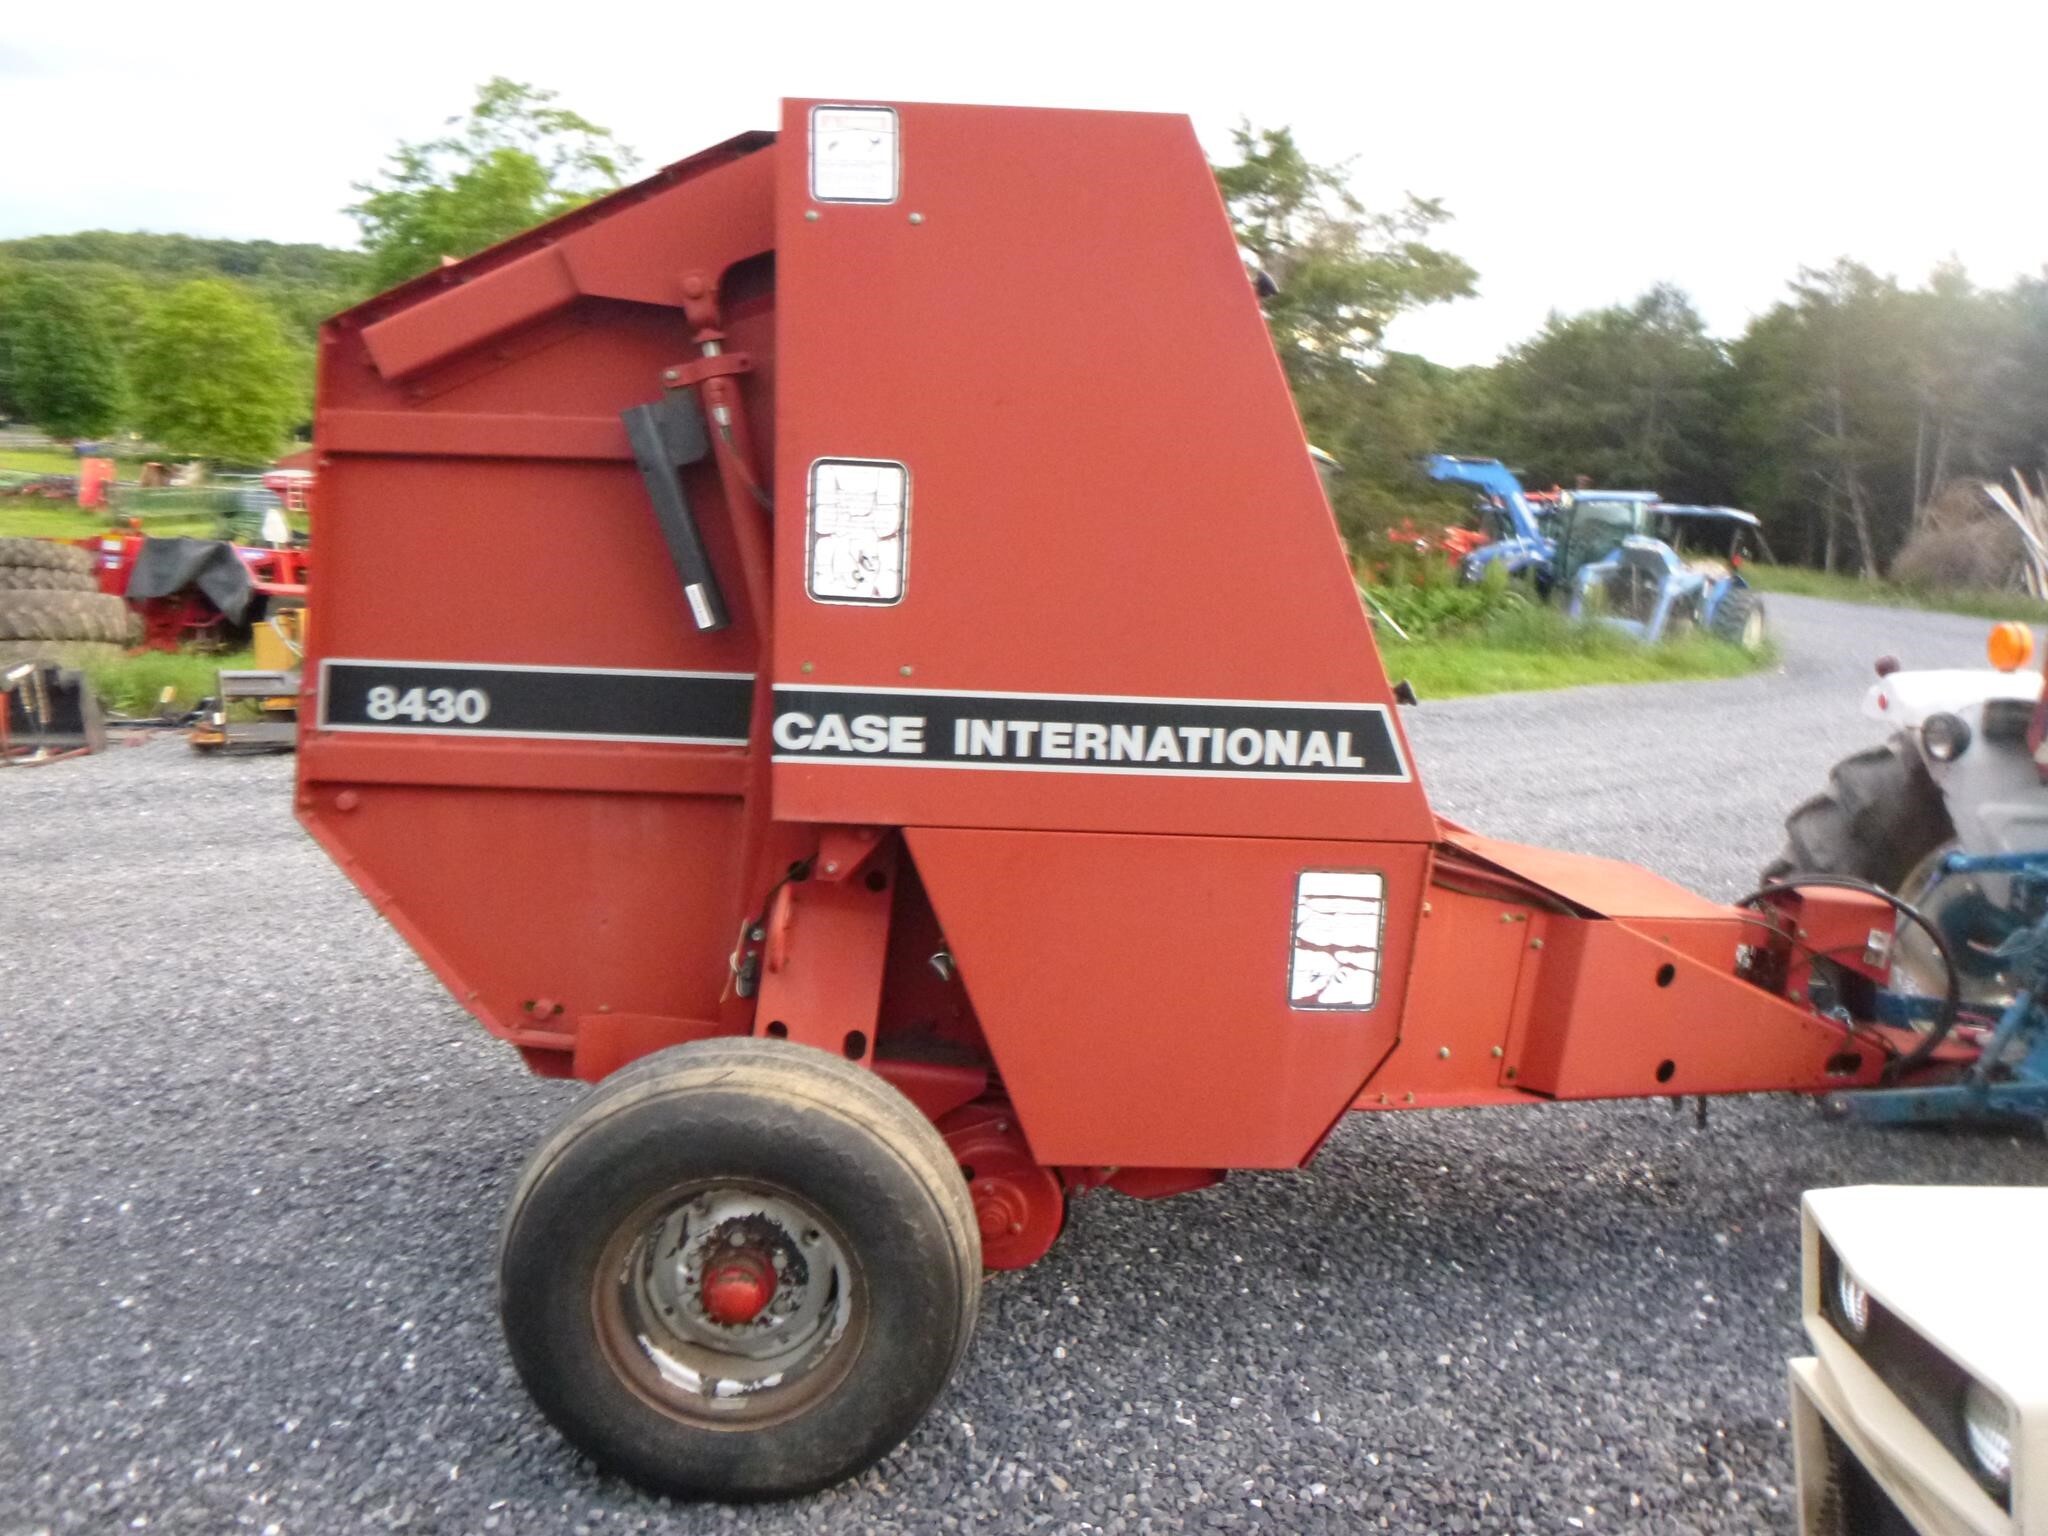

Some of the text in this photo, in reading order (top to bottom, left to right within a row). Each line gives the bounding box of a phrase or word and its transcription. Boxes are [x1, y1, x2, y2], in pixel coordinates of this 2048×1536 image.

[366, 686, 487, 724] 8430
[772, 712, 1365, 768] CASE INTERNATIONAL
